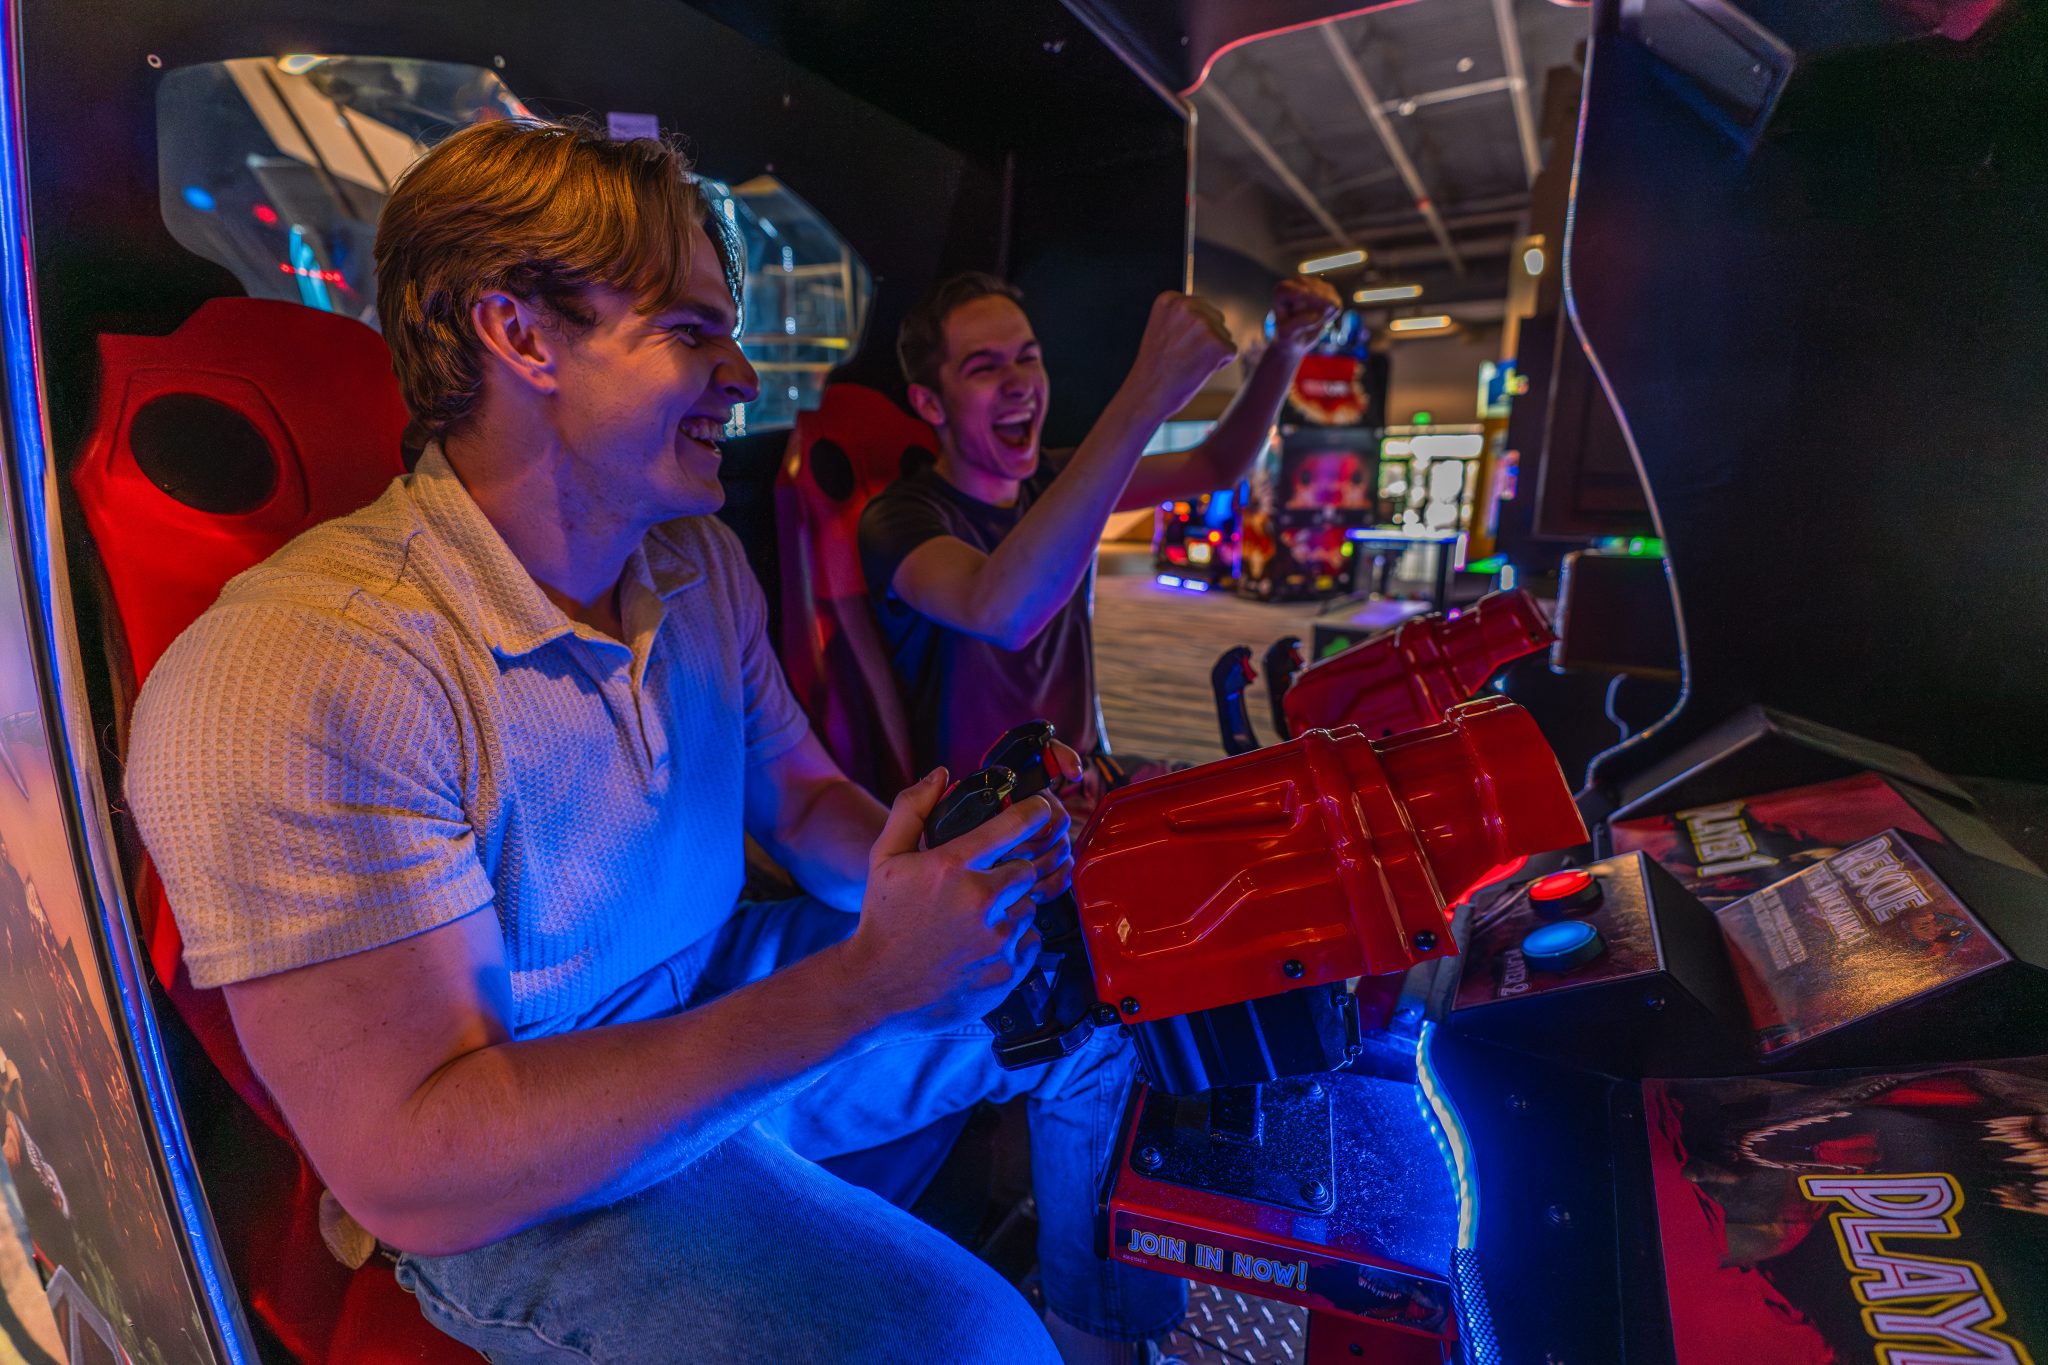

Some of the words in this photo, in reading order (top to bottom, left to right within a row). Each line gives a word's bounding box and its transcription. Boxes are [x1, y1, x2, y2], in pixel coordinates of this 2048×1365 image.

[1802, 863, 1836, 893] THE
[1831, 836, 1933, 925] RESCUE
[1499, 983, 1529, 997] 2
[1129, 1229, 1186, 1263] JOIN
[1195, 1243, 1224, 1272] IN
[1232, 1252, 1308, 1291] NOW!
[1799, 1173, 2033, 1365] PLAY
